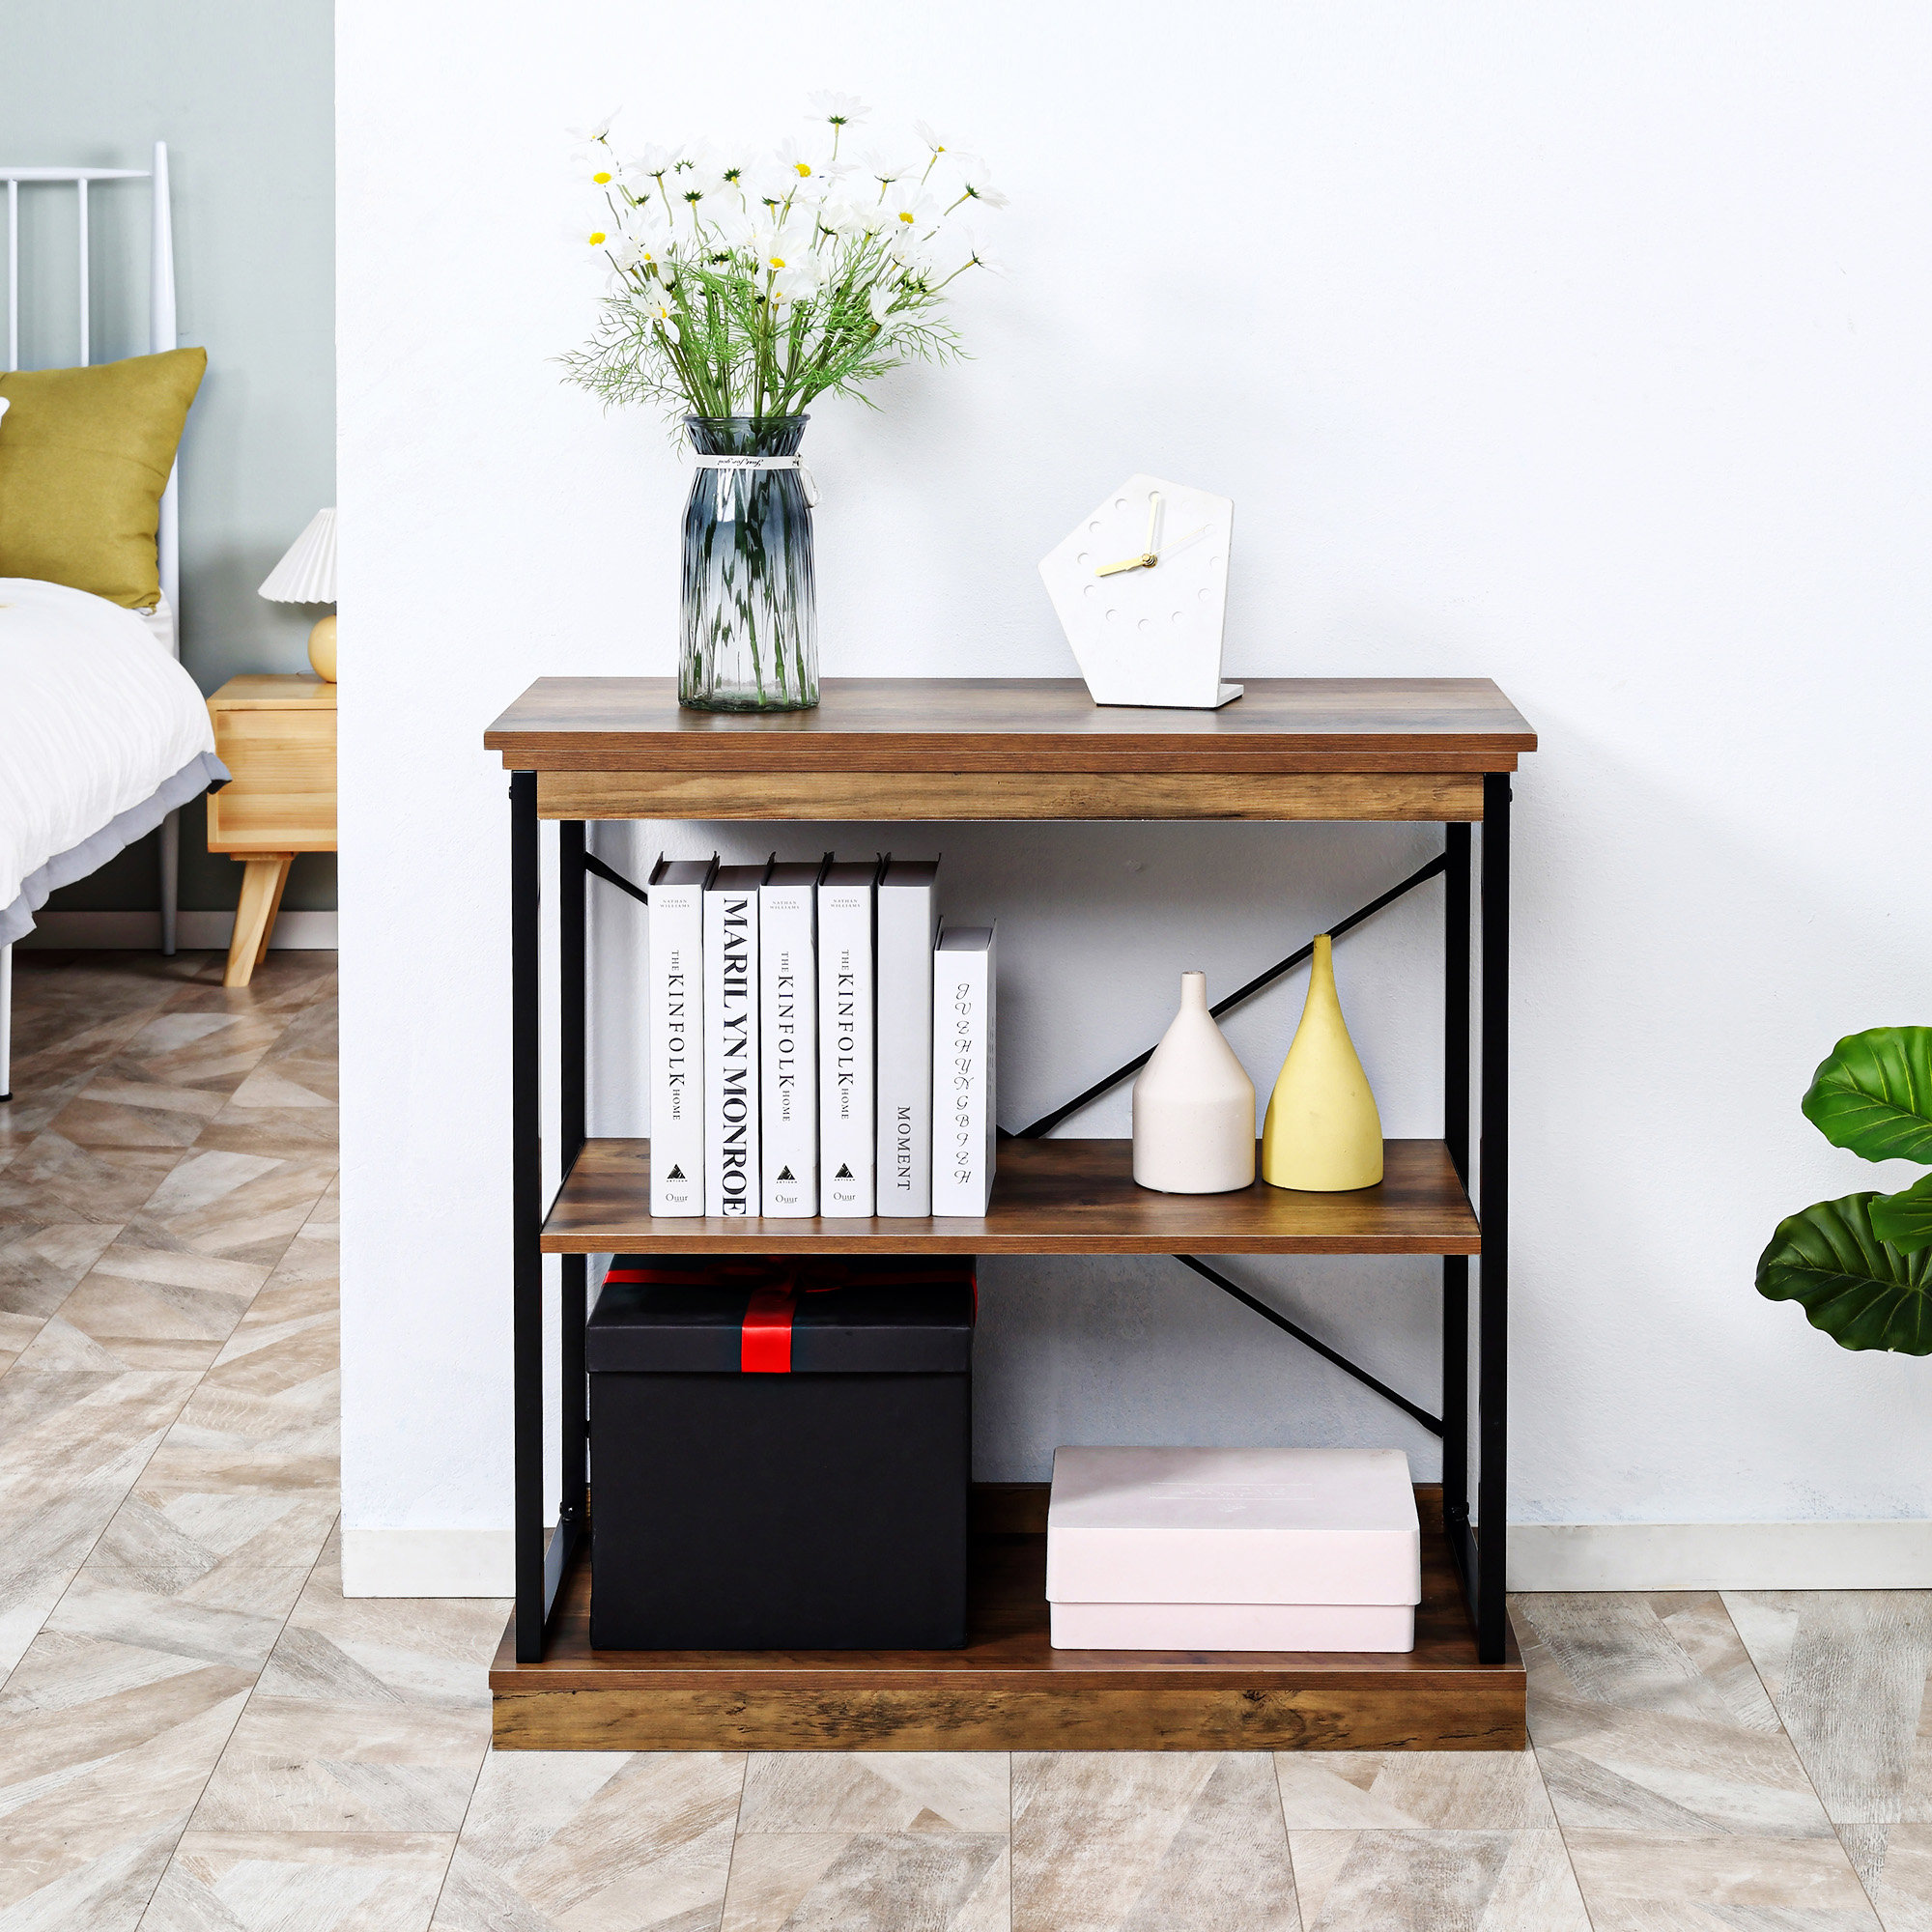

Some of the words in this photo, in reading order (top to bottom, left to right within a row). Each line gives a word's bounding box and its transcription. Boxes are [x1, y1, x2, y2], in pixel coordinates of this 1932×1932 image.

[671, 951, 680, 971] THE
[781, 952, 789, 973] THE
[841, 950, 850, 971] THE
[723, 897, 749, 1060] MARILYN
[668, 974, 685, 1088] KINFOLK
[778, 975, 795, 1089] KINFOLK
[838, 973, 854, 1087] KINFOLK
[672, 1089, 681, 1121] HOME
[781, 1090, 791, 1122] HOME
[840, 1088, 849, 1120] HOME
[722, 1066, 749, 1217] MONROE
[896, 1105, 912, 1191] MOMENT
[665, 1193, 689, 1202] Ouur
[775, 1194, 798, 1203] Ouur
[833, 1192, 856, 1201] Ouur
